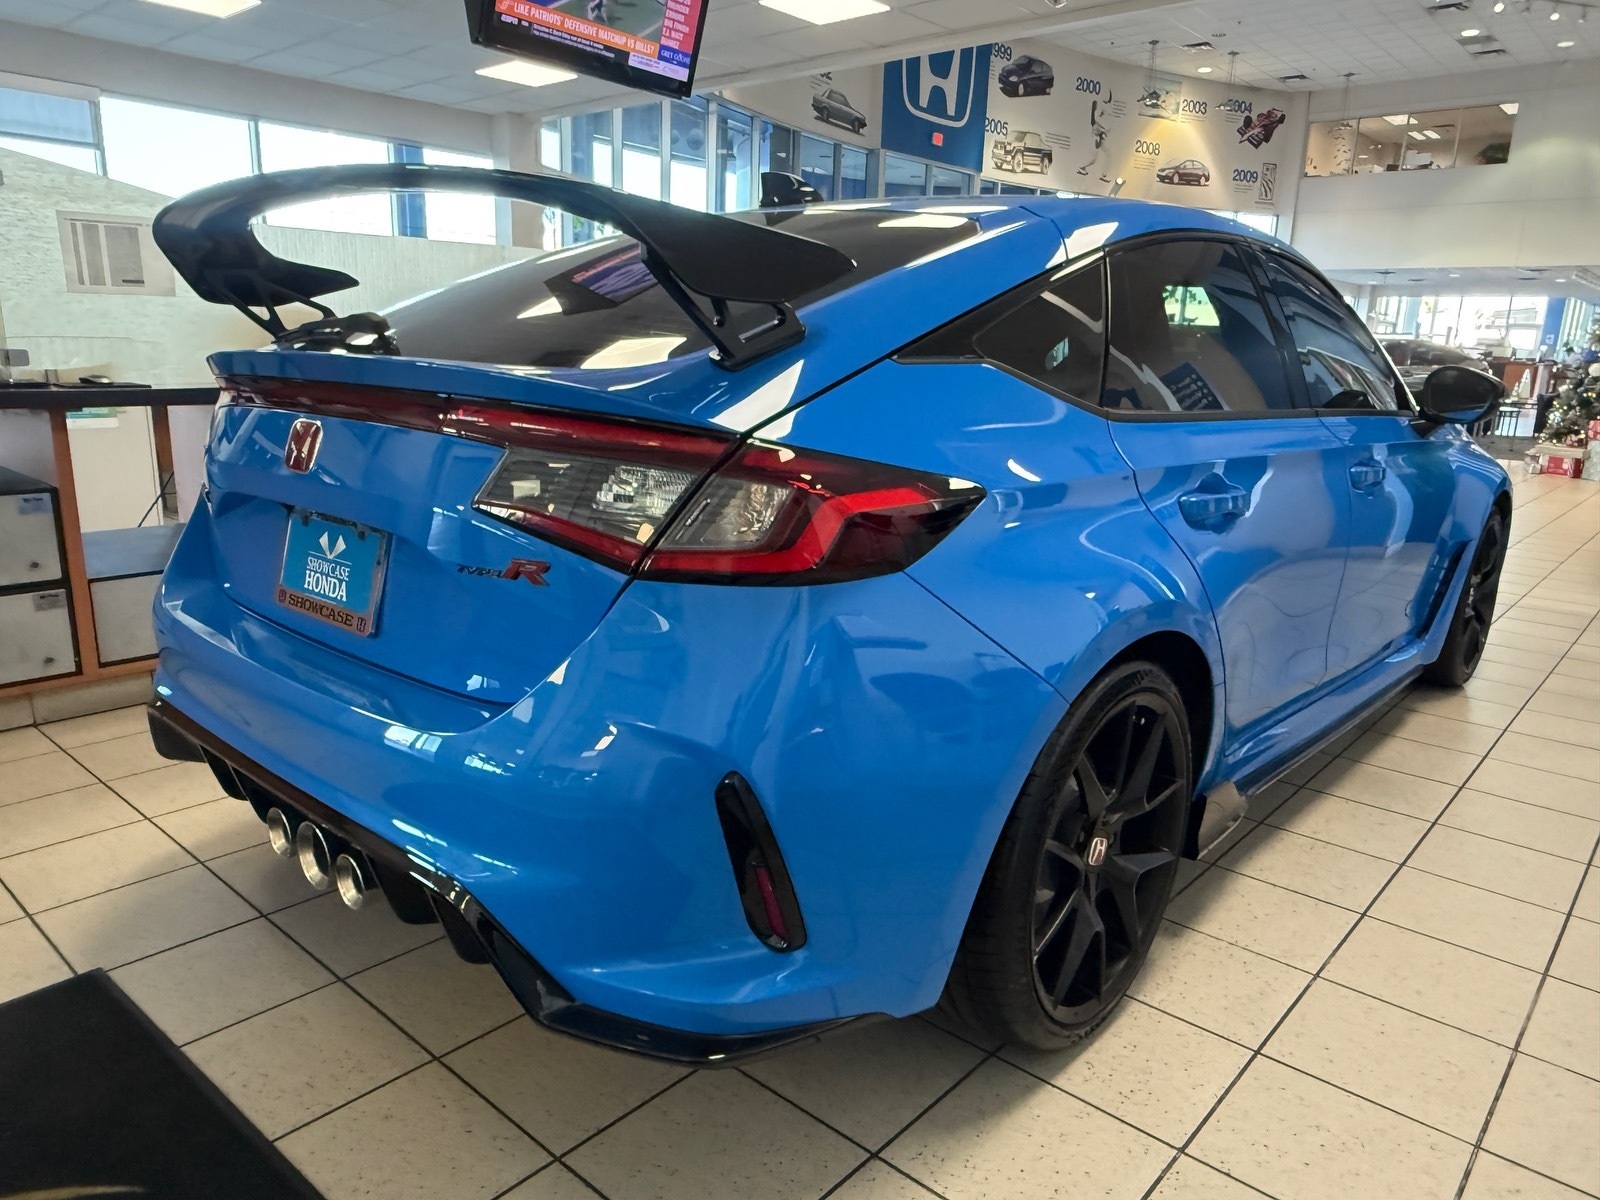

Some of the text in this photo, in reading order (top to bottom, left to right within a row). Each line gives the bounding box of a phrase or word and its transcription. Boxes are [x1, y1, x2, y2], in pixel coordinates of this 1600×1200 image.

[514, 2, 529, 17] LIKE
[530, 7, 563, 26] PATRIOTS'
[564, 17, 598, 37] DEFENSIVE
[598, 28, 627, 45] MATCHUP
[627, 38, 635, 49] VS
[635, 40, 655, 54] BILLS?
[1076, 77, 1101, 95] 2000
[1182, 99, 1208, 115] 2003
[984, 117, 1008, 137] 2005
[1134, 139, 1160, 156] 2008
[1232, 168, 1258, 184] 2009
[306, 556, 350, 581] SHOWCASE
[502, 558, 551, 586] R
[303, 570, 347, 602] HONDA
[288, 593, 354, 627] SHOWCASE
